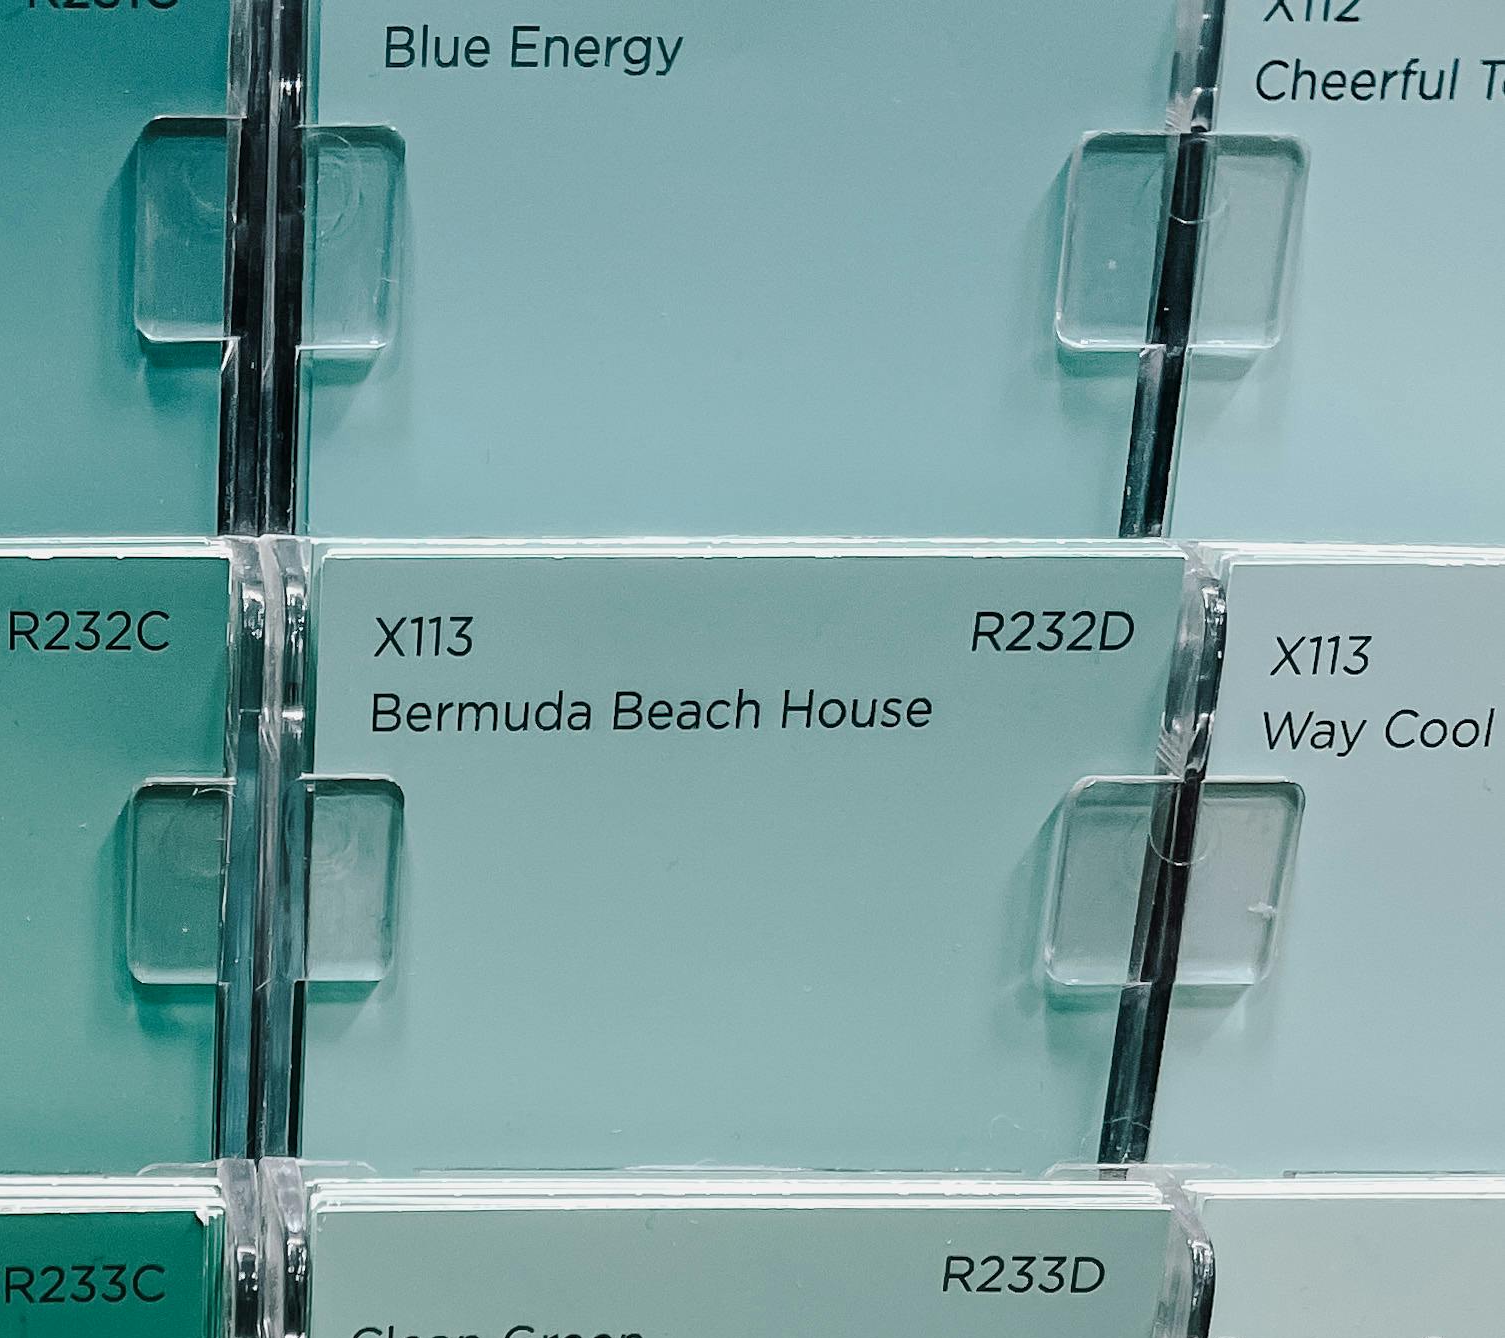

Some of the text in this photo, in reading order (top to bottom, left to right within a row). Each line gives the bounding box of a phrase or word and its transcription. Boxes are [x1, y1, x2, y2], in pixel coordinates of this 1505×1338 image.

[385, 24, 684, 76] Blue Energy
[1255, 58, 1505, 101] Cheerful T
[9, 610, 170, 651] R232C
[374, 616, 474, 657] X113
[971, 610, 1135, 652] R232D
[1270, 635, 1372, 676] X113
[372, 688, 932, 732] Bermuda Beach House
[1263, 708, 1495, 757] Way Cool
[5, 1264, 165, 1304] R233C
[942, 1255, 1106, 1294] R233D
